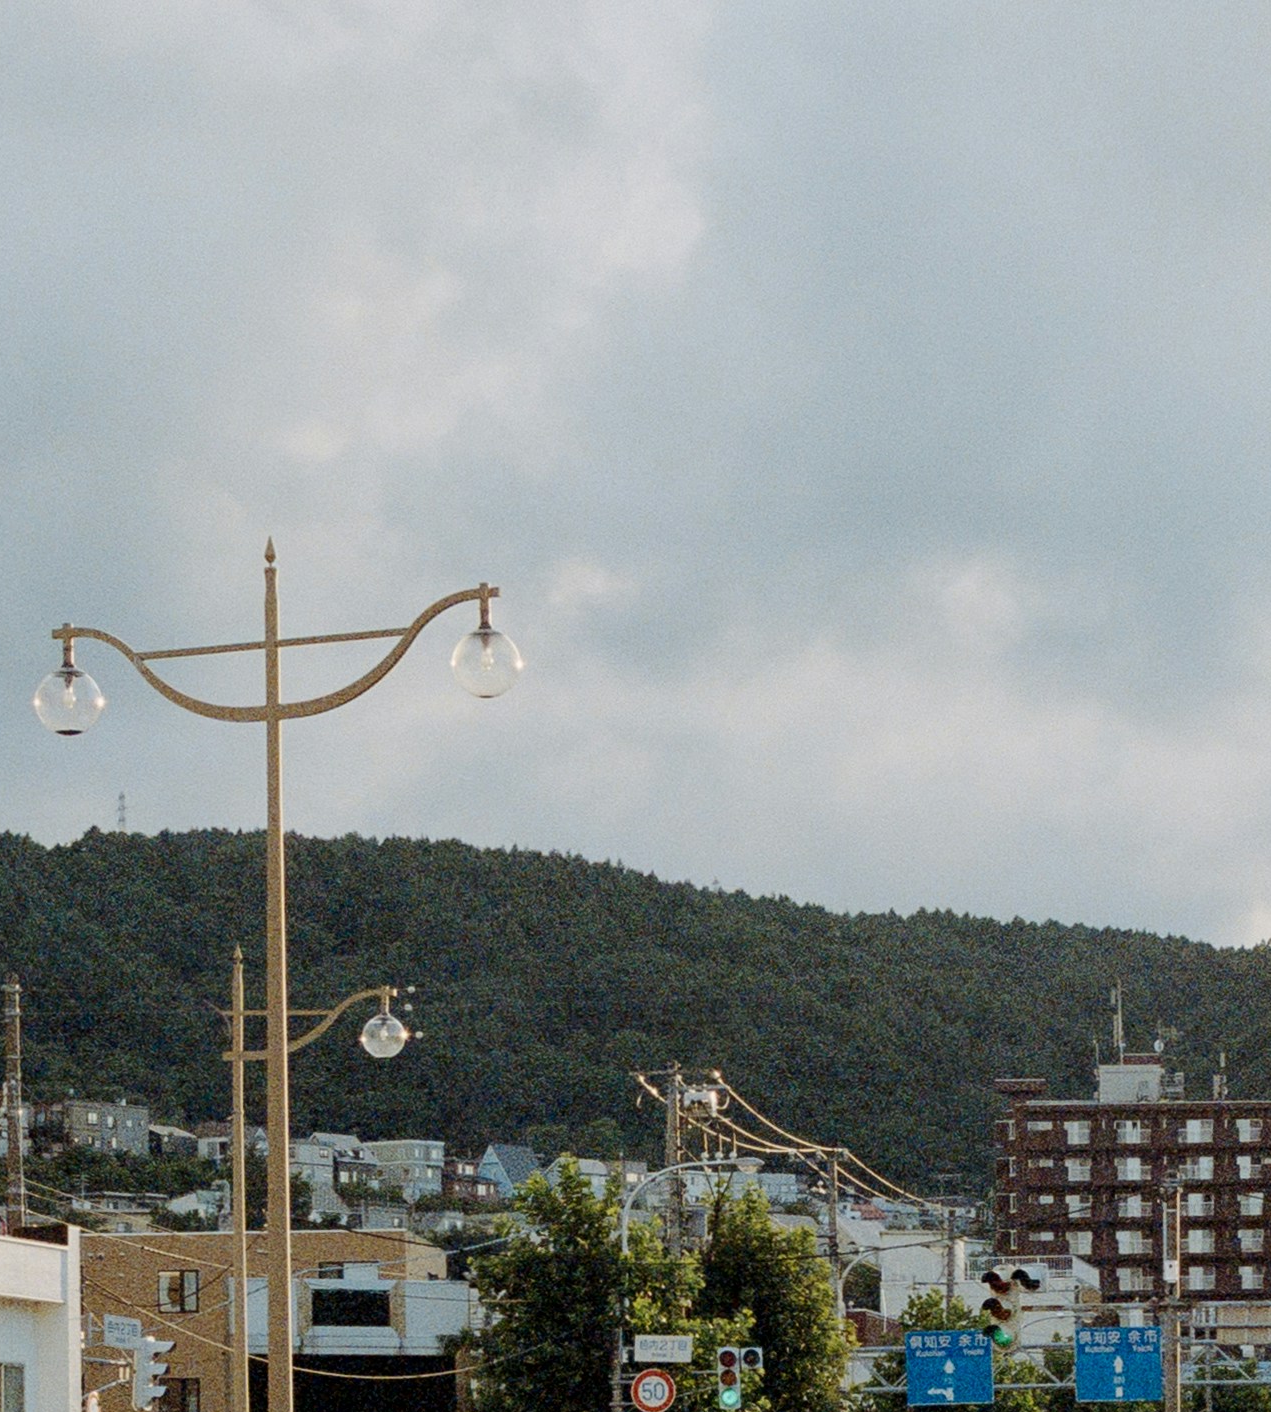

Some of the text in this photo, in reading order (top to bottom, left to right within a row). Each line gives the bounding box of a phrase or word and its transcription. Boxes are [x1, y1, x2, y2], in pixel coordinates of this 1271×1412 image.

[958, 1333, 988, 1347] 余市
[1128, 1330, 1158, 1344] 余市
[641, 1382, 666, 1401] 50
